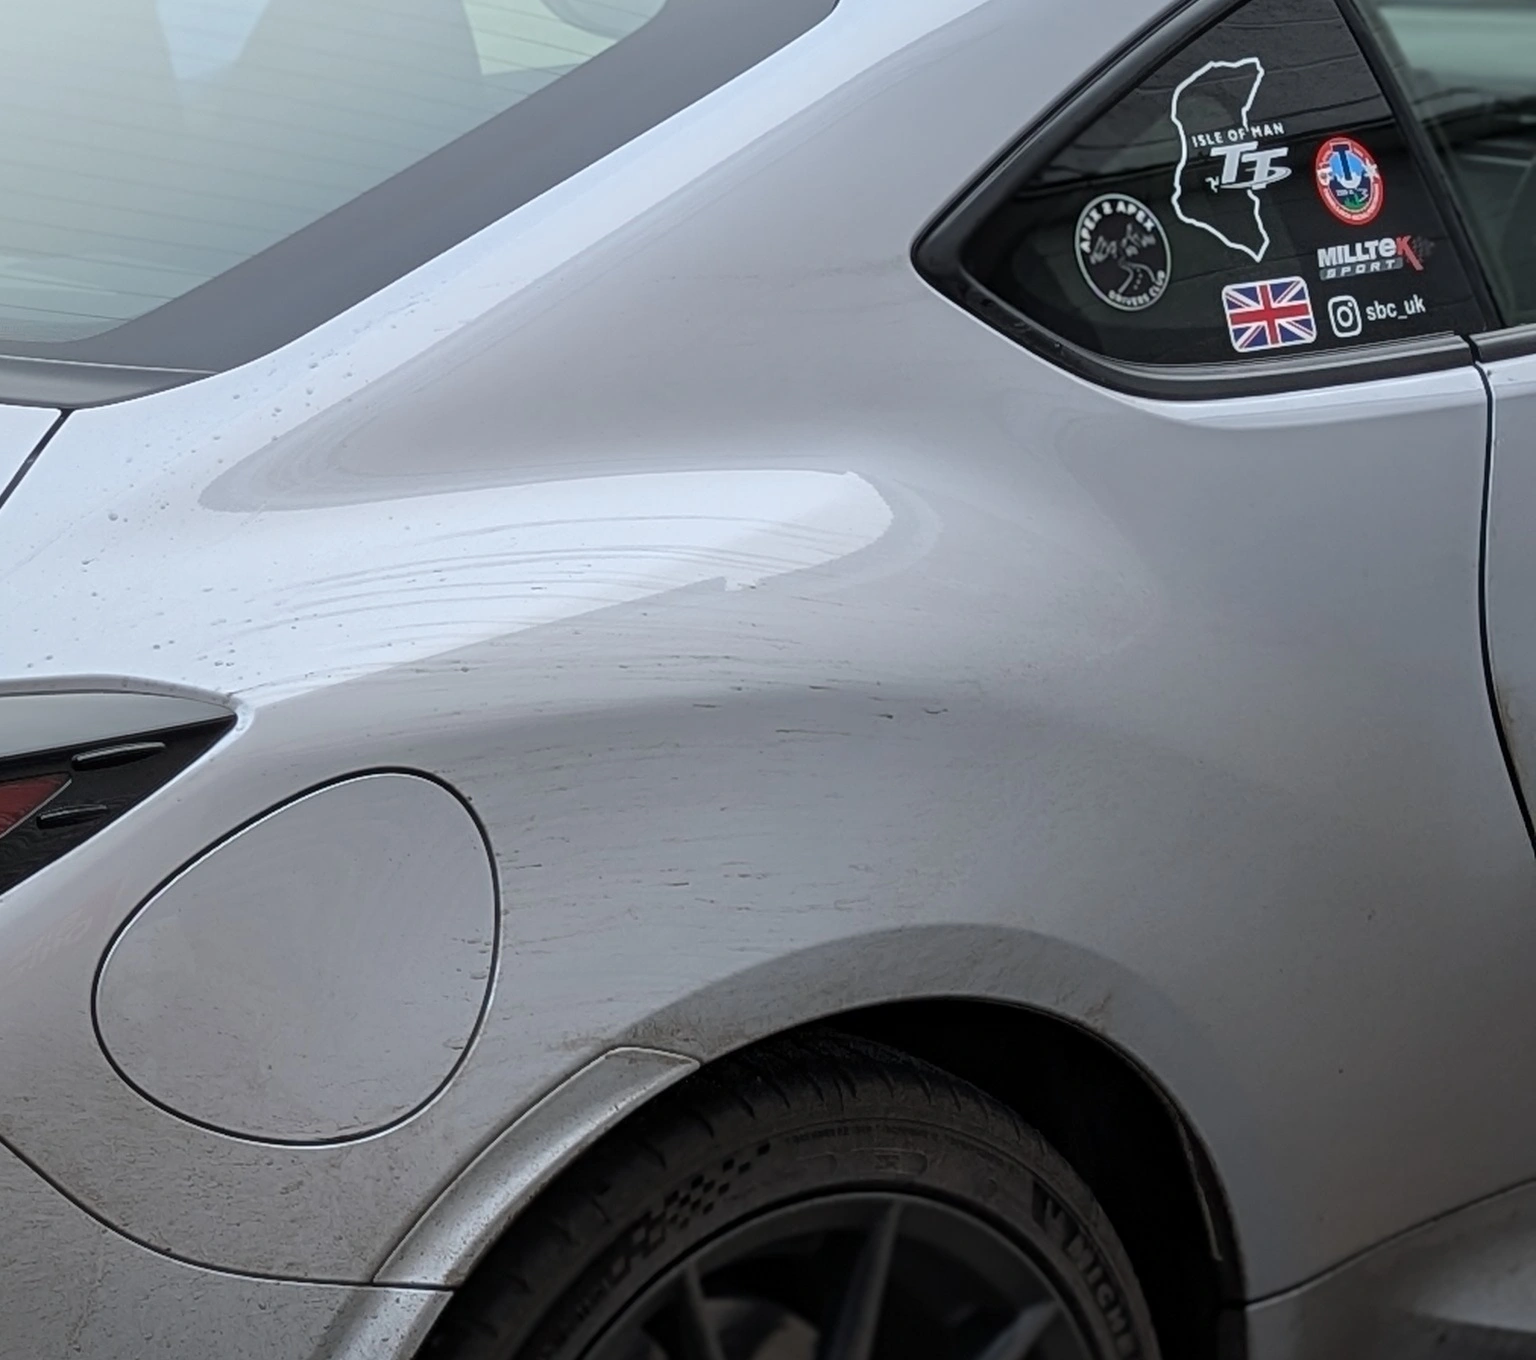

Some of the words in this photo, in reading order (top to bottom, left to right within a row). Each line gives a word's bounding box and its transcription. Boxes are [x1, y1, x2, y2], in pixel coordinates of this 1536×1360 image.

[1191, 131, 1224, 148] ISLE
[1227, 127, 1246, 142] OF
[1250, 122, 1285, 138] MAN
[1080, 208, 1103, 254] APEX
[1115, 200, 1155, 232] APEX
[1325, 259, 1396, 280] SPORT
[1365, 293, 1427, 321] sbc_uk
